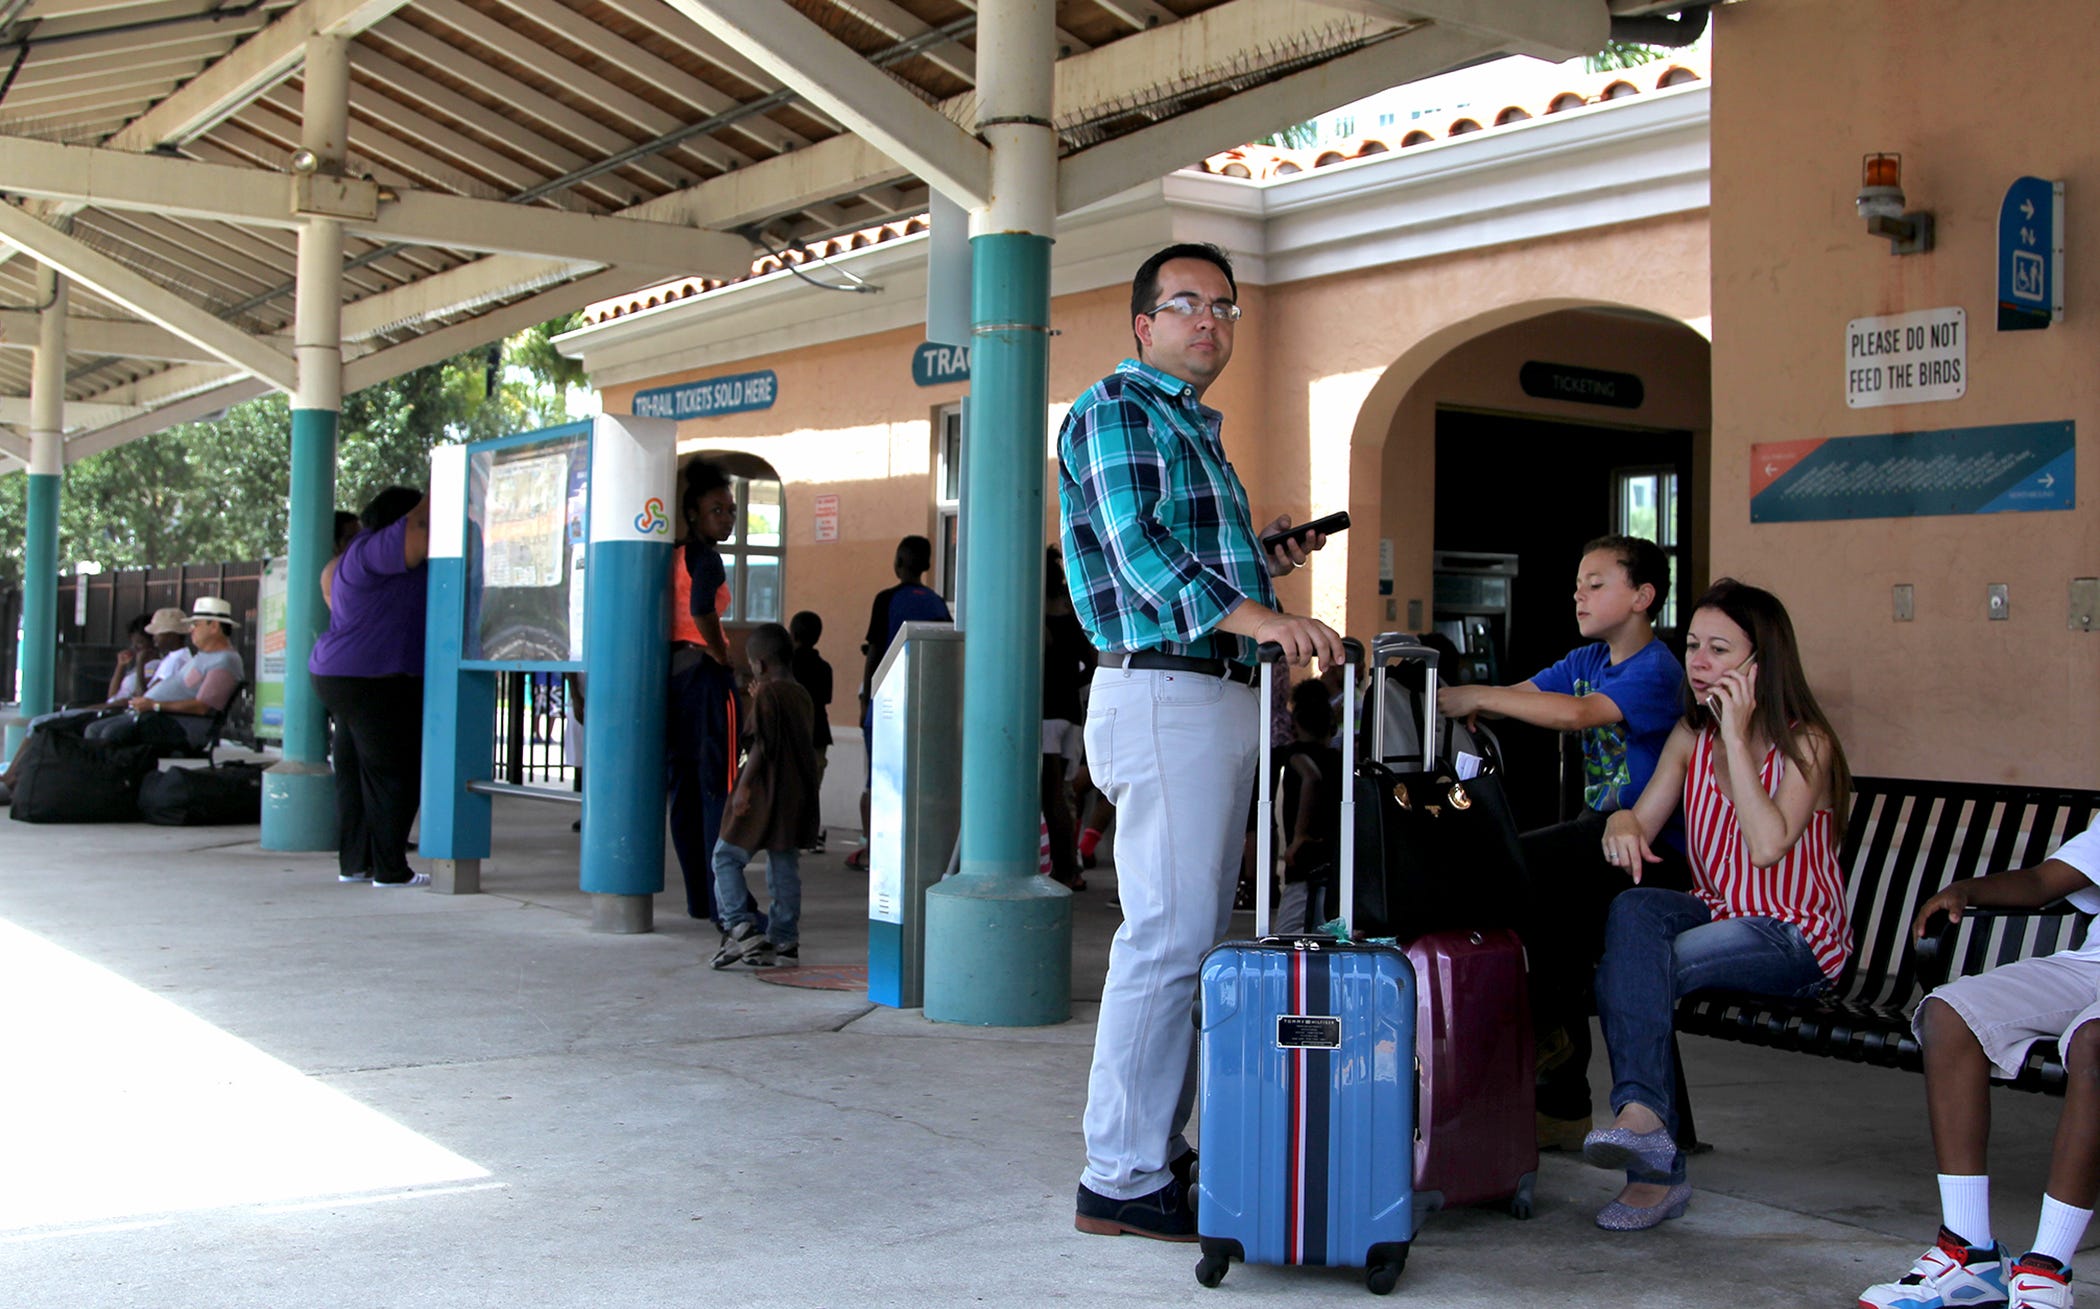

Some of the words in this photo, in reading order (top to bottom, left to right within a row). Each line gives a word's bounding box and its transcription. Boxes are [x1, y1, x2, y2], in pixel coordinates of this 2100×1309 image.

[1851, 329, 1900, 358] PLEASE
[1906, 326, 1924, 352] DO
[1931, 321, 1959, 348] NOT
[1553, 374, 1616, 399] TICKETING
[1850, 367, 1882, 393] FEED
[1888, 363, 1913, 389] THE
[1919, 358, 1961, 387] BIRDS
[675, 386, 712, 414] TICKETS
[713, 380, 742, 408] SOLD
[744, 376, 773, 405] HERE
